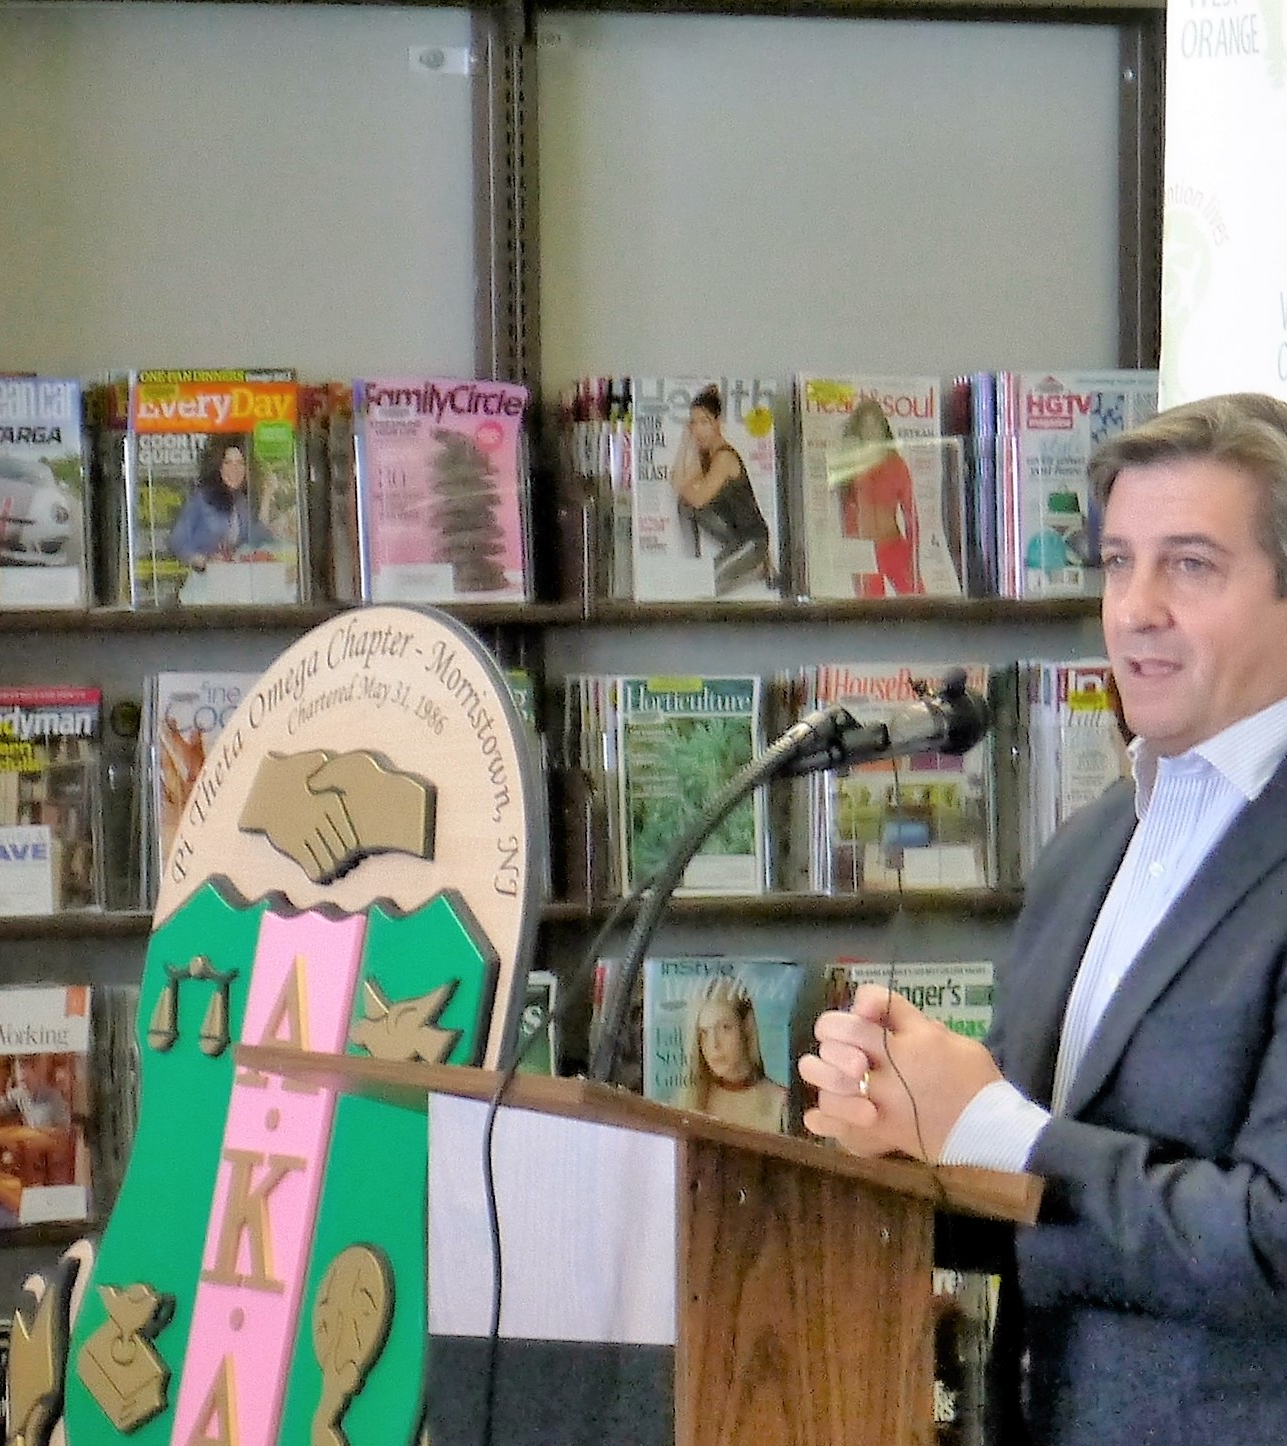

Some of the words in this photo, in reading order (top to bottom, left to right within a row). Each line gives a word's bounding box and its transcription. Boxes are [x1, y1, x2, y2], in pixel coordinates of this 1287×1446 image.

[1180, 13, 1261, 59] ORANGE
[1026, 394, 1092, 414] HGTV
[286, 671, 354, 736] Chartered
[357, 675, 390, 709] May
[389, 679, 412, 708] 31,
[413, 693, 451, 736] 1986
[171, 833, 194, 886] Pi
[189, 729, 243, 828] Theta
[246, 648, 319, 730] Omega
[324, 617, 411, 670] Chapter
[424, 638, 512, 824] Morristown,
[494, 835, 520, 899] NJ
